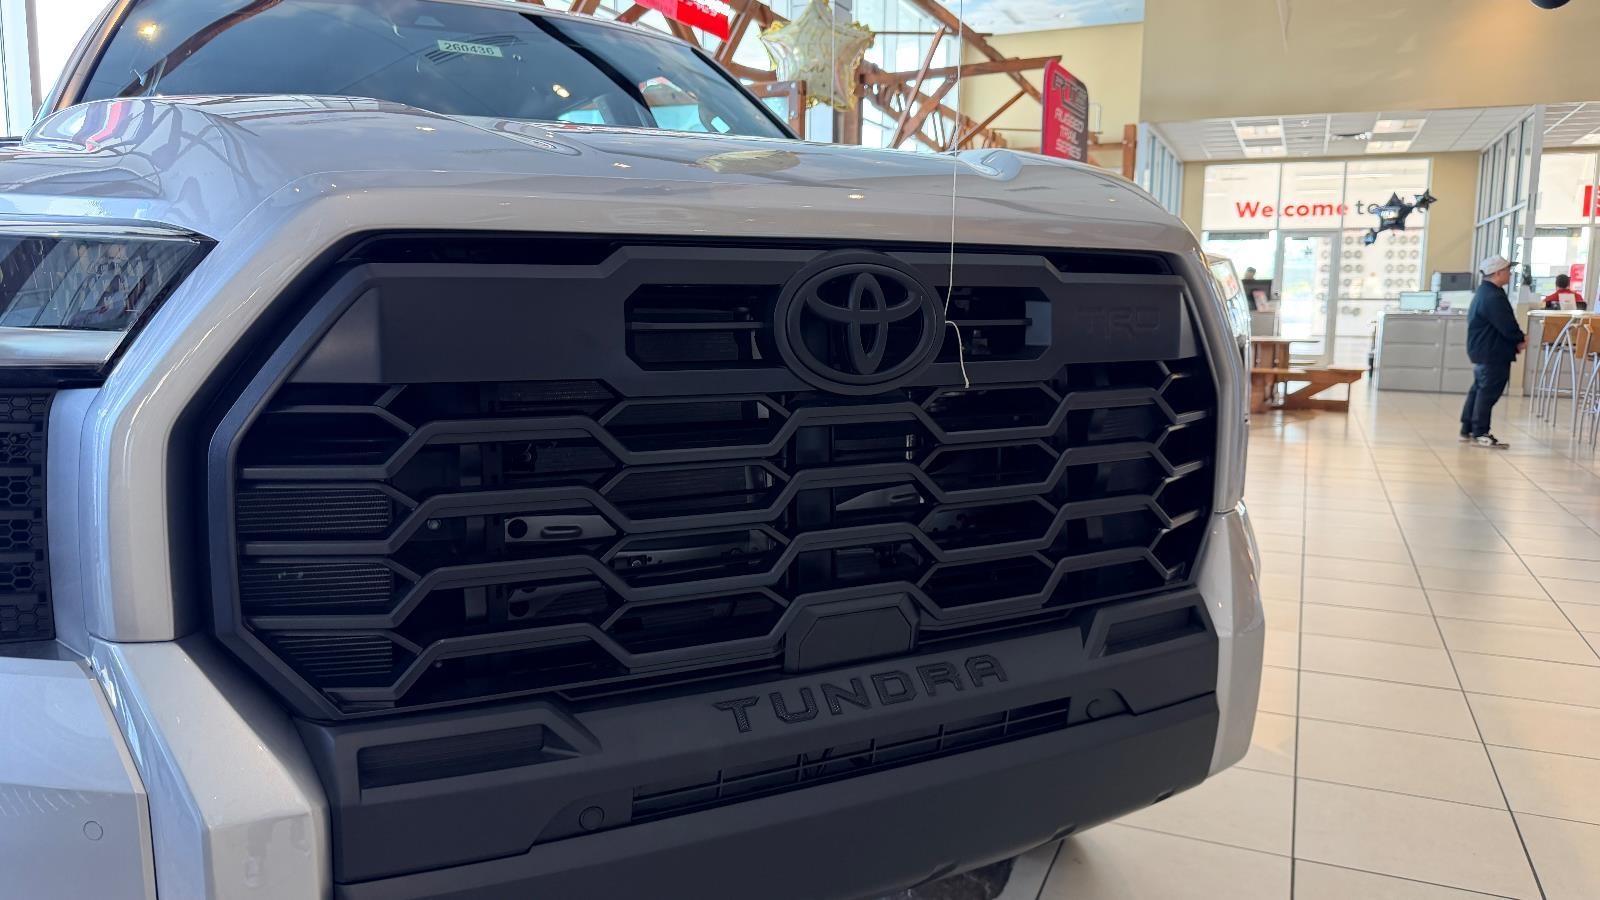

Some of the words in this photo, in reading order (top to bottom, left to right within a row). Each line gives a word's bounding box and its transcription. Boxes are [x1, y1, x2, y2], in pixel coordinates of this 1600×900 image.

[1236, 201, 1348, 218] Wecome
[1073, 304, 1161, 344] TRD
[712, 654, 1008, 733] TUNDRA
